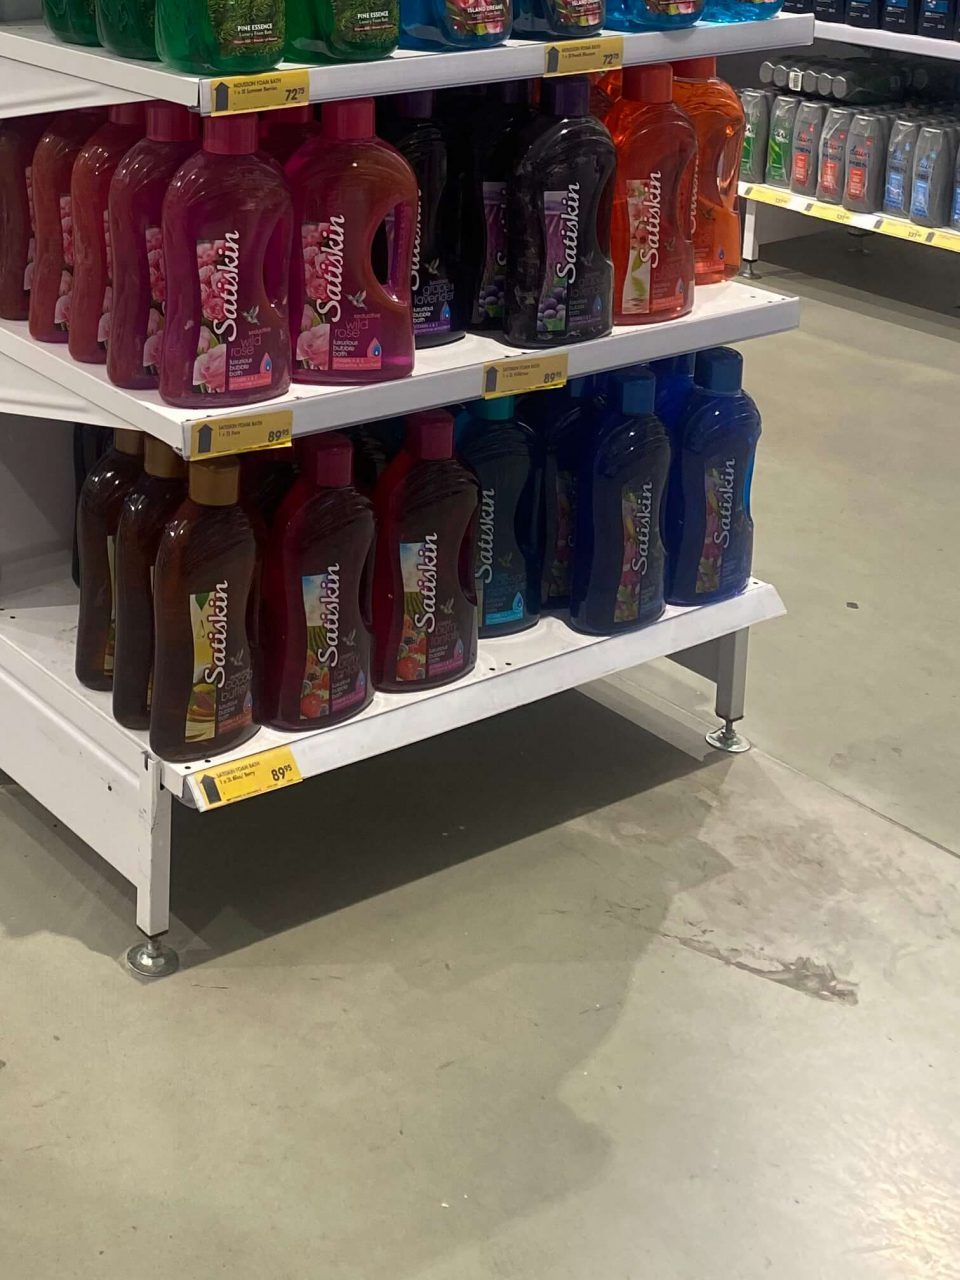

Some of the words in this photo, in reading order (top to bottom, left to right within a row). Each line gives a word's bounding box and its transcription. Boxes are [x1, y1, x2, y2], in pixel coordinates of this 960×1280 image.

[238, 24, 253, 32] PINE
[254, 23, 273, 31] ESSENCE
[556, 181, 580, 285] Satiskin
[640, 170, 662, 269] Satiskin
[214, 229, 240, 342] Satiskin
[316, 214, 346, 323] Satiskin
[414, 291, 454, 305] lavender
[422, 284, 449, 297] grape
[230, 346, 254, 357] rose
[241, 335, 262, 346] wild
[334, 328, 360, 338] rose
[346, 320, 369, 329] wild
[475, 487, 495, 584] Satiskin
[631, 481, 653, 576] Satiskin
[713, 458, 736, 549] Satiskin
[317, 562, 340, 668] Satiskin
[414, 532, 439, 634] Satiskin
[204, 579, 229, 688] Satiskin
[216, 769, 236, 778] SATISKIN
[236, 764, 249, 773] FOAM
[249, 761, 260, 769] BATH
